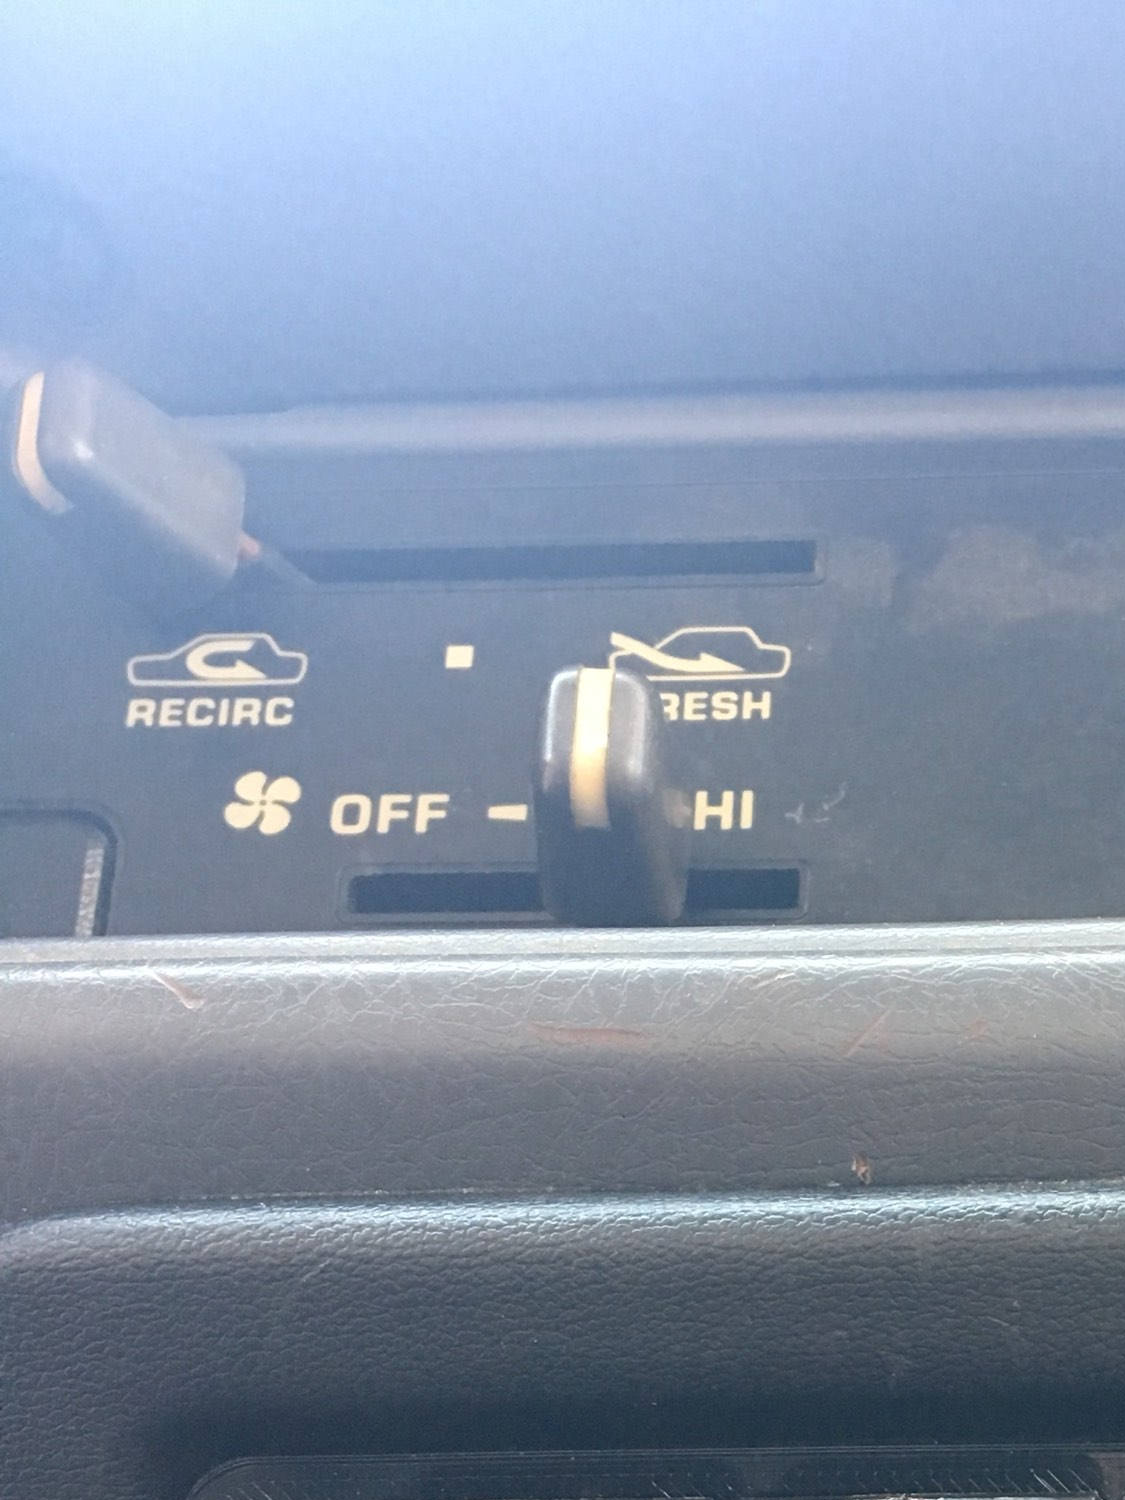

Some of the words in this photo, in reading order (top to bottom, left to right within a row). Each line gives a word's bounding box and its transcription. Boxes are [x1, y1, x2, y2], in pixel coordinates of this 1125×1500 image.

[126, 696, 295, 728] RECIRC
[659, 690, 772, 721] RESH
[329, 793, 450, 835] OFF
[693, 790, 754, 831] HI
